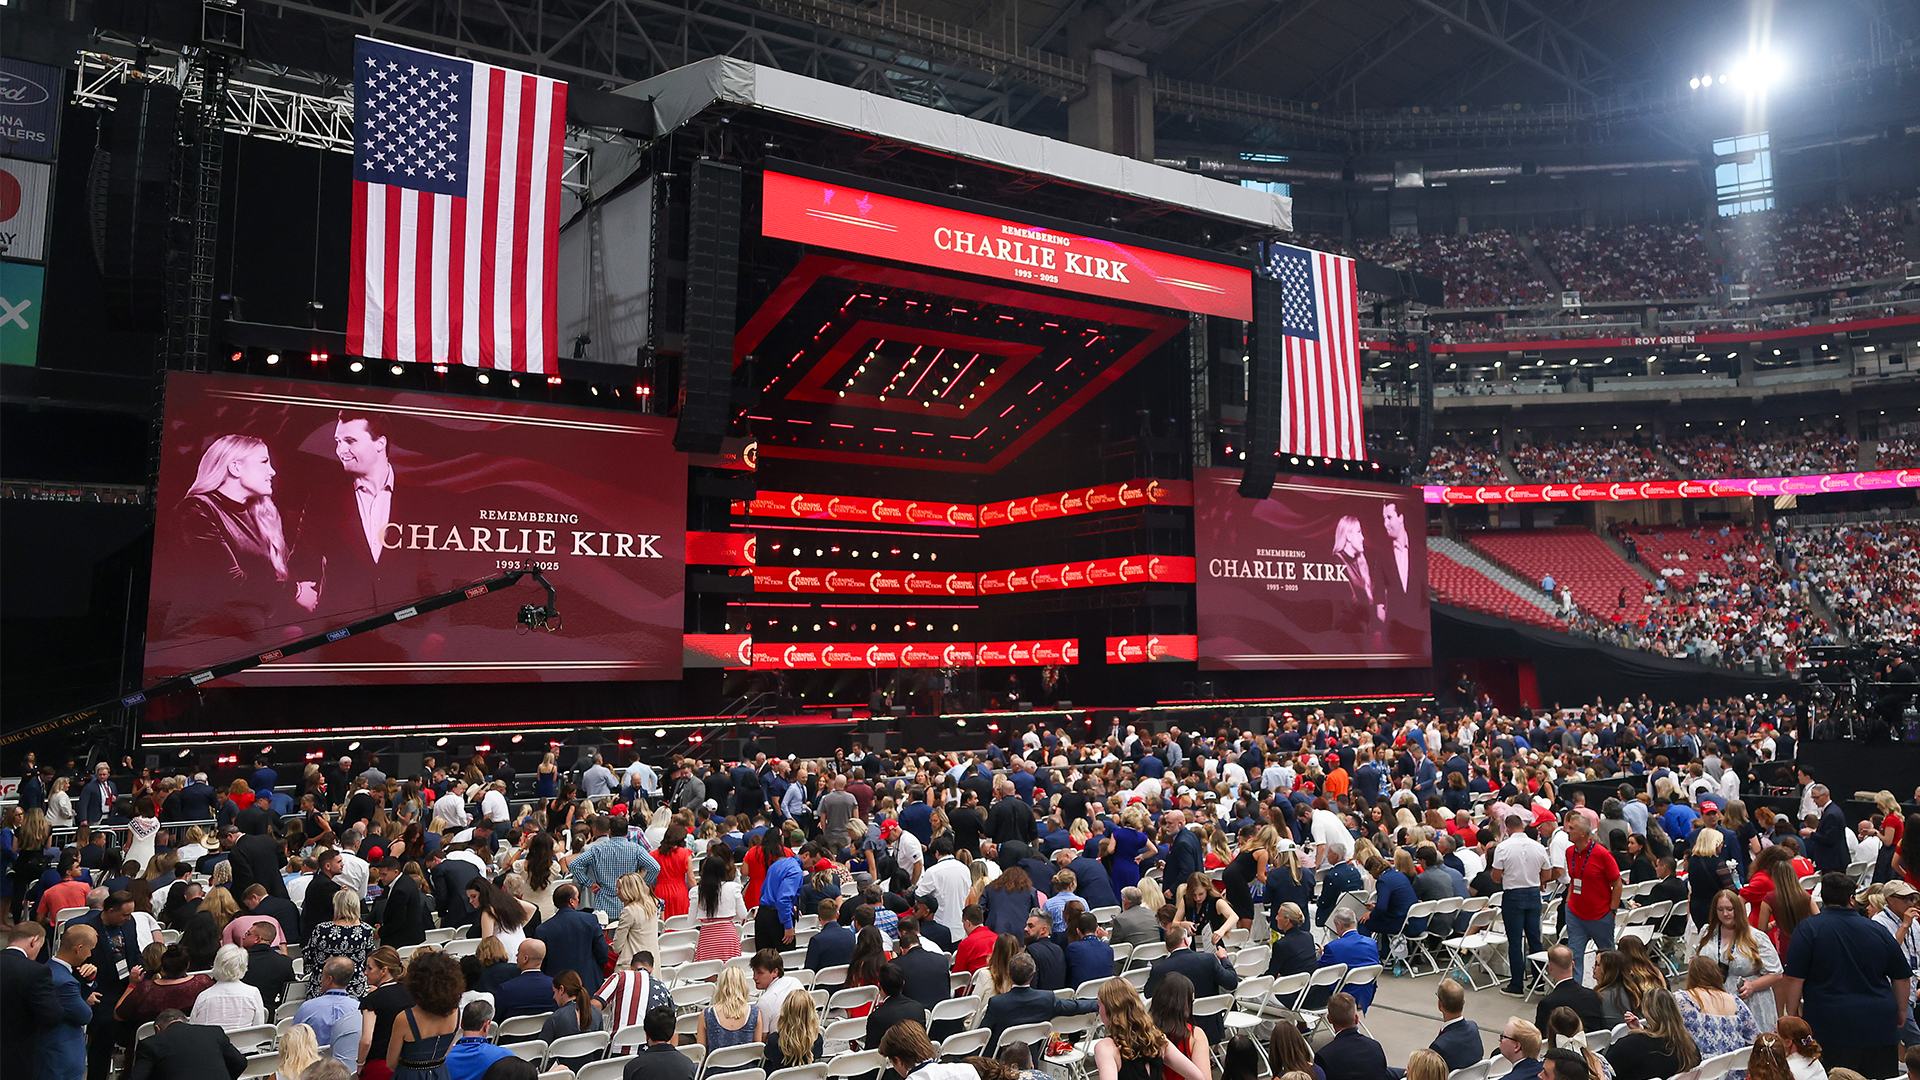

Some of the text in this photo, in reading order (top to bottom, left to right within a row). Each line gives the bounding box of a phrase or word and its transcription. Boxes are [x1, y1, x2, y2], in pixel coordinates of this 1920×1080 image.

[1002, 225, 1070, 246] REMEMBERING
[934, 227, 1130, 284] CHARLIE KIRK
[1014, 268, 1032, 278] 1993
[1040, 273, 1058, 283] 2025
[1635, 337, 1656, 345] ROY
[1660, 336, 1695, 344] GREEN
[480, 510, 579, 524] REMEMBERING
[378, 522, 663, 559] CHARLIE KIRK
[1256, 549, 1306, 558] REMEMBERING
[496, 560, 521, 570] 1993
[533, 562, 559, 571] 2025
[1209, 558, 1350, 582] CHARLIE KIRK
[30, 720, 60, 736] GREAT
[61, 711, 89, 726] AGAIN
